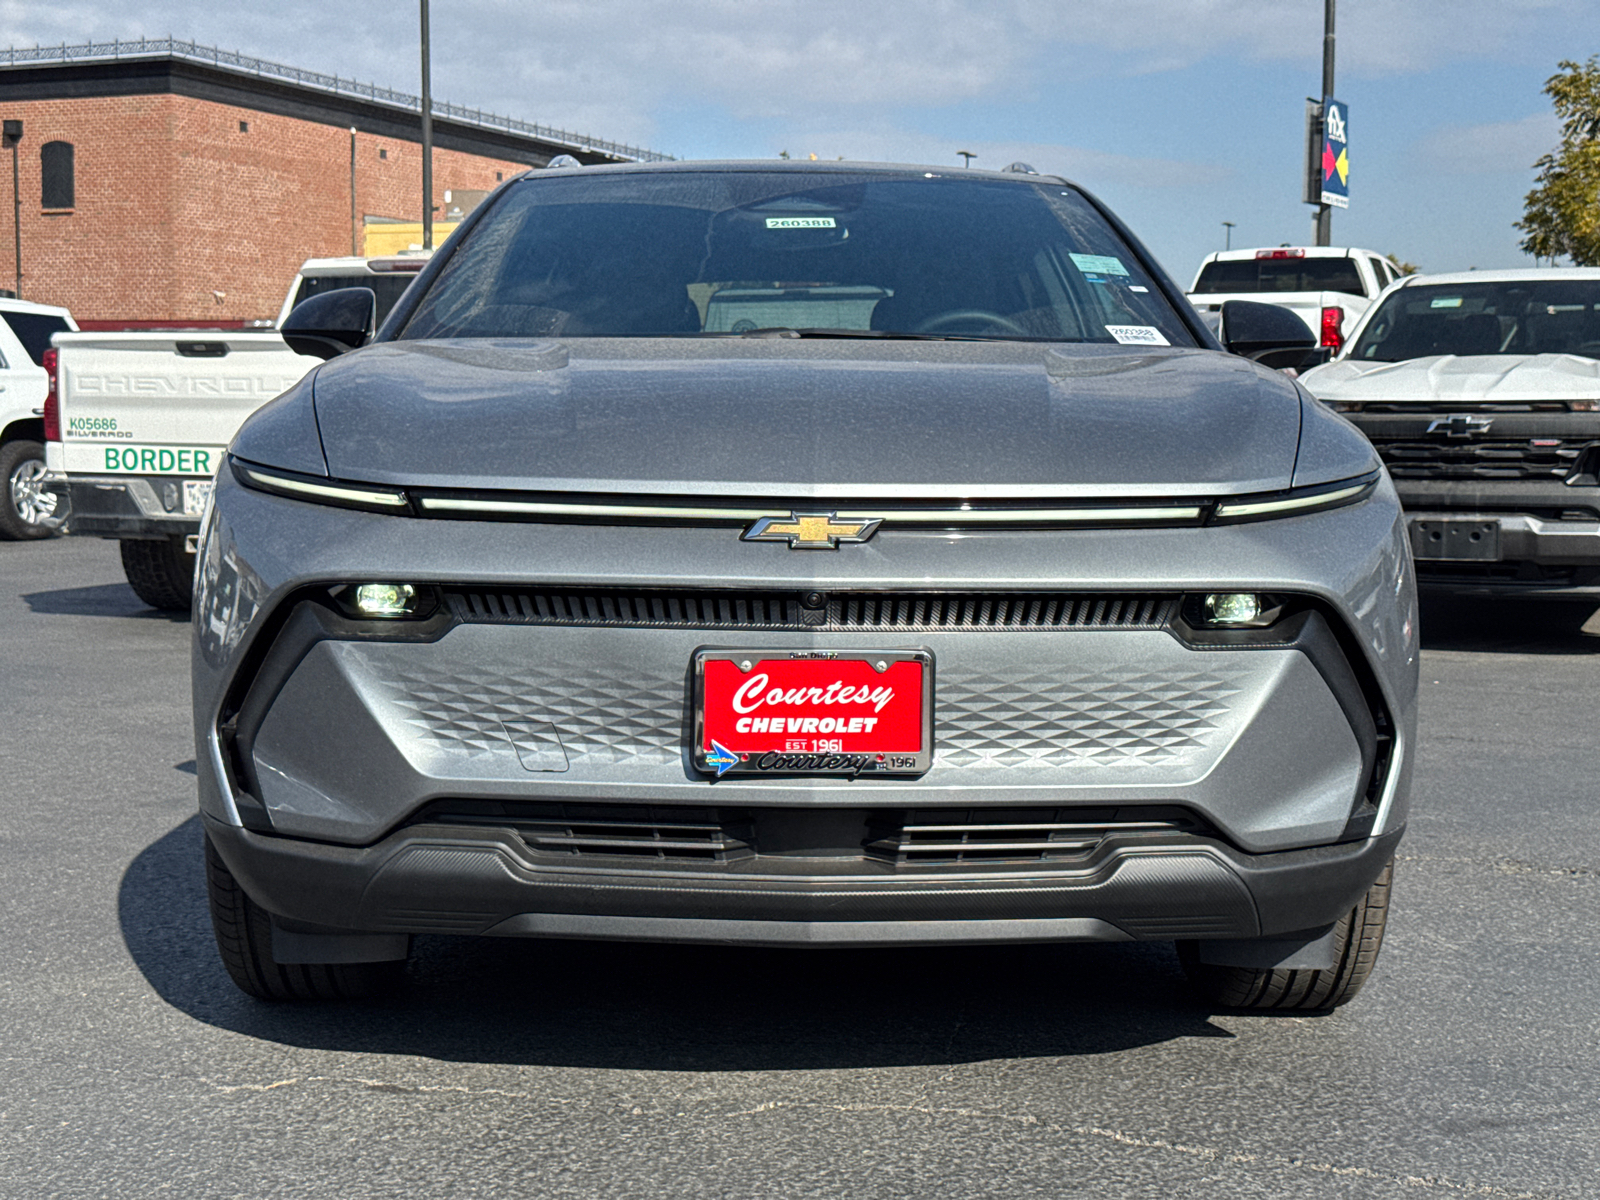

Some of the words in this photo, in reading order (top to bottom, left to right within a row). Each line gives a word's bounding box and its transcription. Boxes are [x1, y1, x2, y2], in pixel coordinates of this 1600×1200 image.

[76, 376, 301, 396] CHEVROL
[69, 417, 118, 431] K05686
[66, 430, 133, 439] SILVERADO
[104, 447, 211, 473] BORDER
[732, 673, 895, 713] Courtesy
[735, 717, 878, 733] CHEVROLET
[785, 741, 808, 750] EST
[811, 739, 843, 752] 1961
[757, 749, 870, 776] Courtesy
[890, 756, 916, 768] 1961
